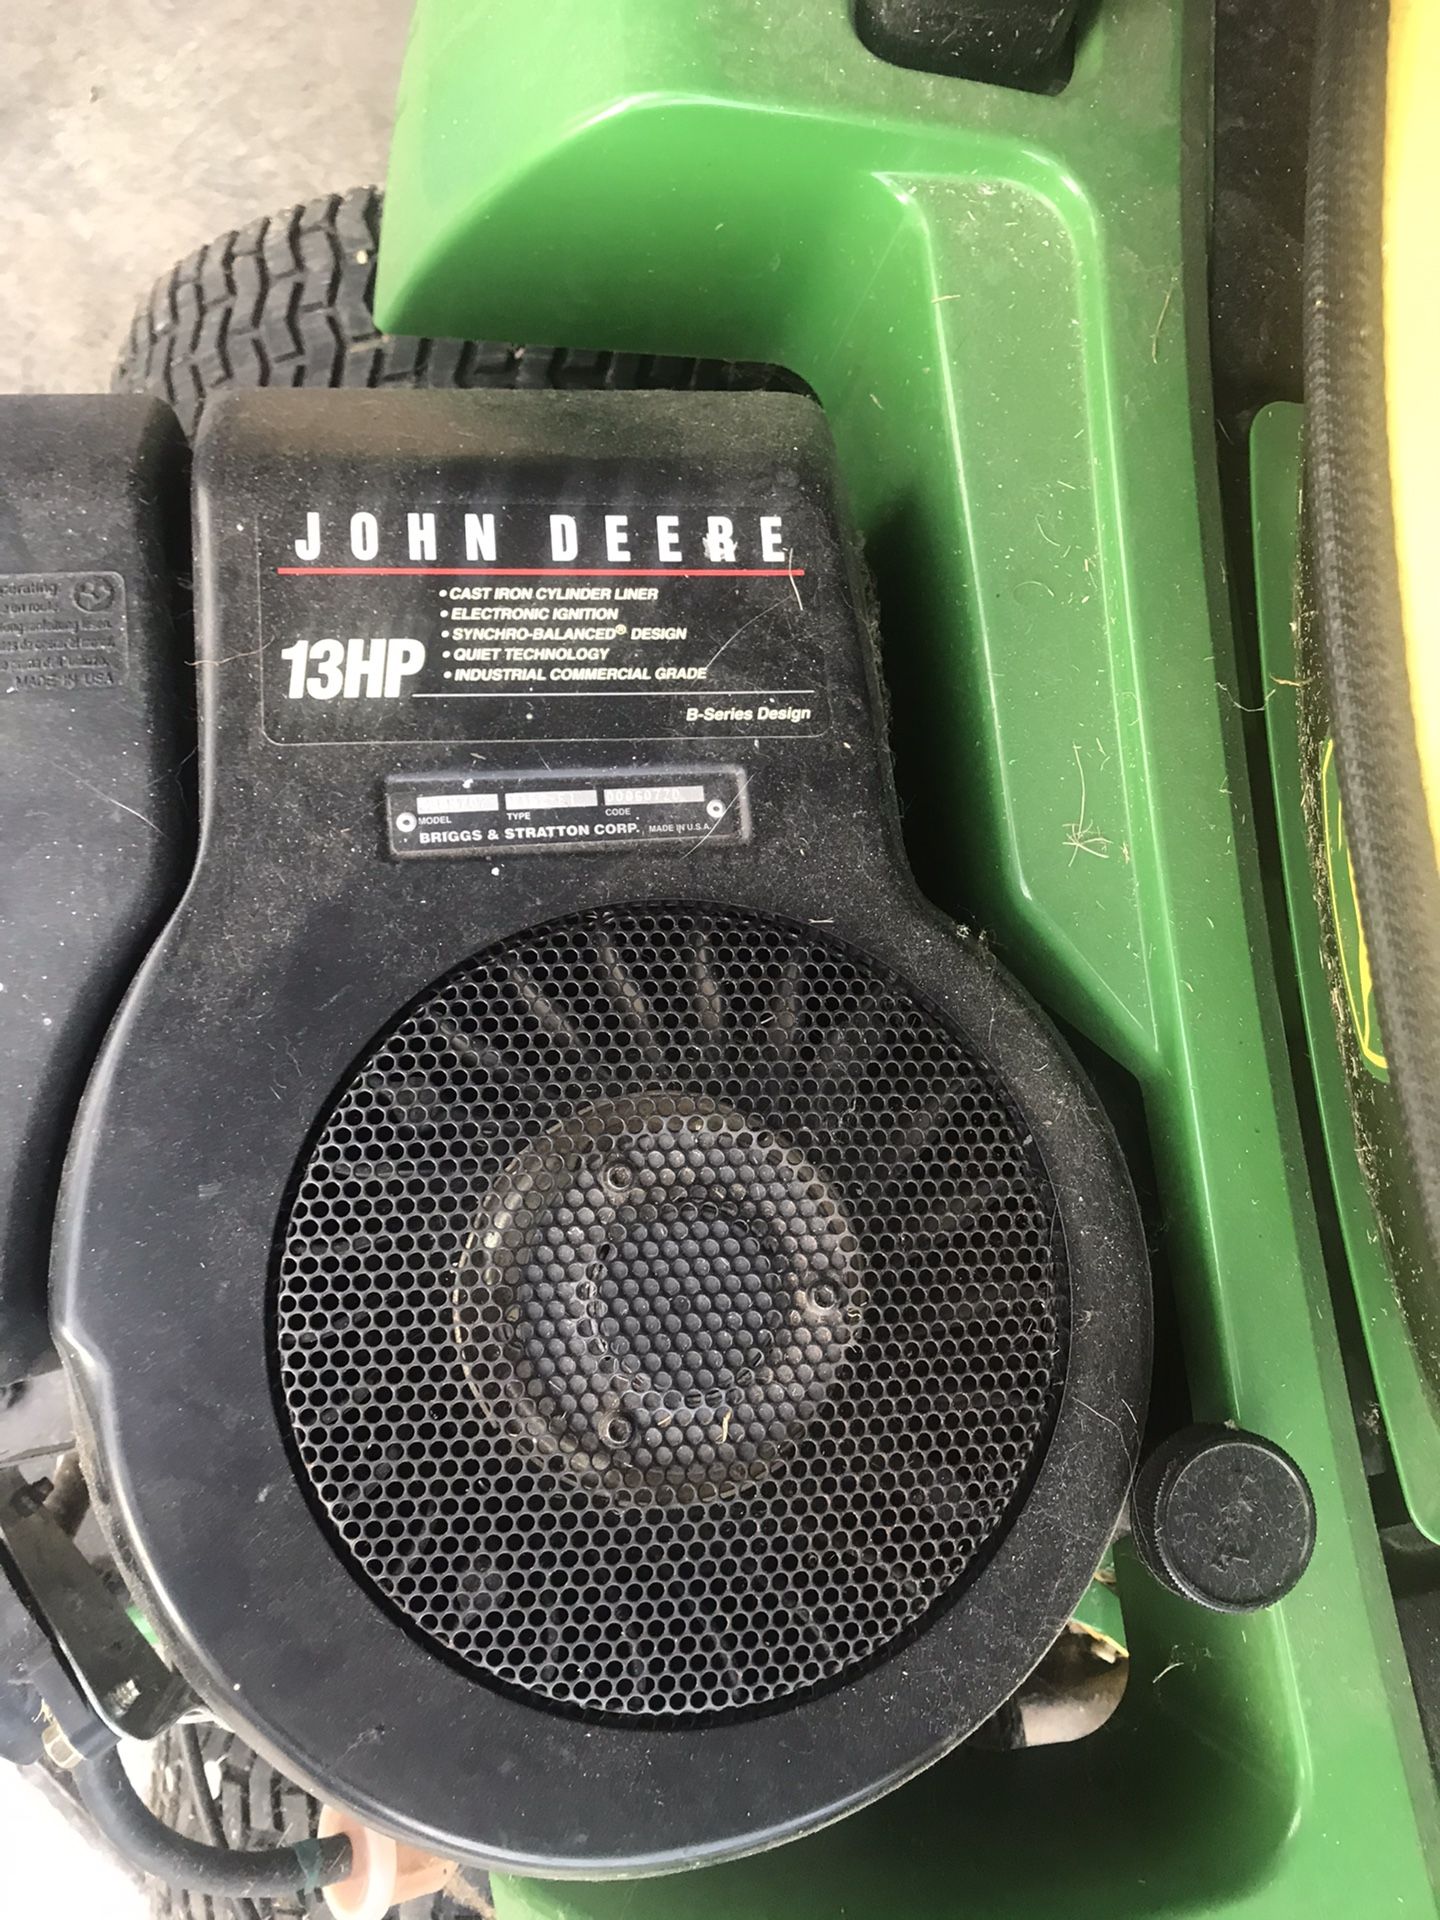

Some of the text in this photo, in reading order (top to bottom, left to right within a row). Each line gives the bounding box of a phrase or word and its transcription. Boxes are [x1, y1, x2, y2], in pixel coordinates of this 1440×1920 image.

[295, 512, 786, 562] JOHN DEERE
[450, 588, 659, 600] CAST IRON CYLINDER LINER
[451, 608, 619, 620] ELECTRONIC IGNITION
[631, 628, 687, 640] DESIGN
[454, 648, 610, 661] QUIET TECHNOLOGY
[281, 638, 426, 700] 13HP
[454, 668, 708, 681] INDUSTRIAL COMMERCIAL GRADE
[686, 706, 812, 722] B-Series Design
[506, 812, 531, 820] TYPE
[605, 808, 631, 816] CODE
[418, 816, 452, 825] MODEL
[419, 823, 640, 844] BRIGGS & STRATTON CORP.
[649, 824, 674, 832] MADE
